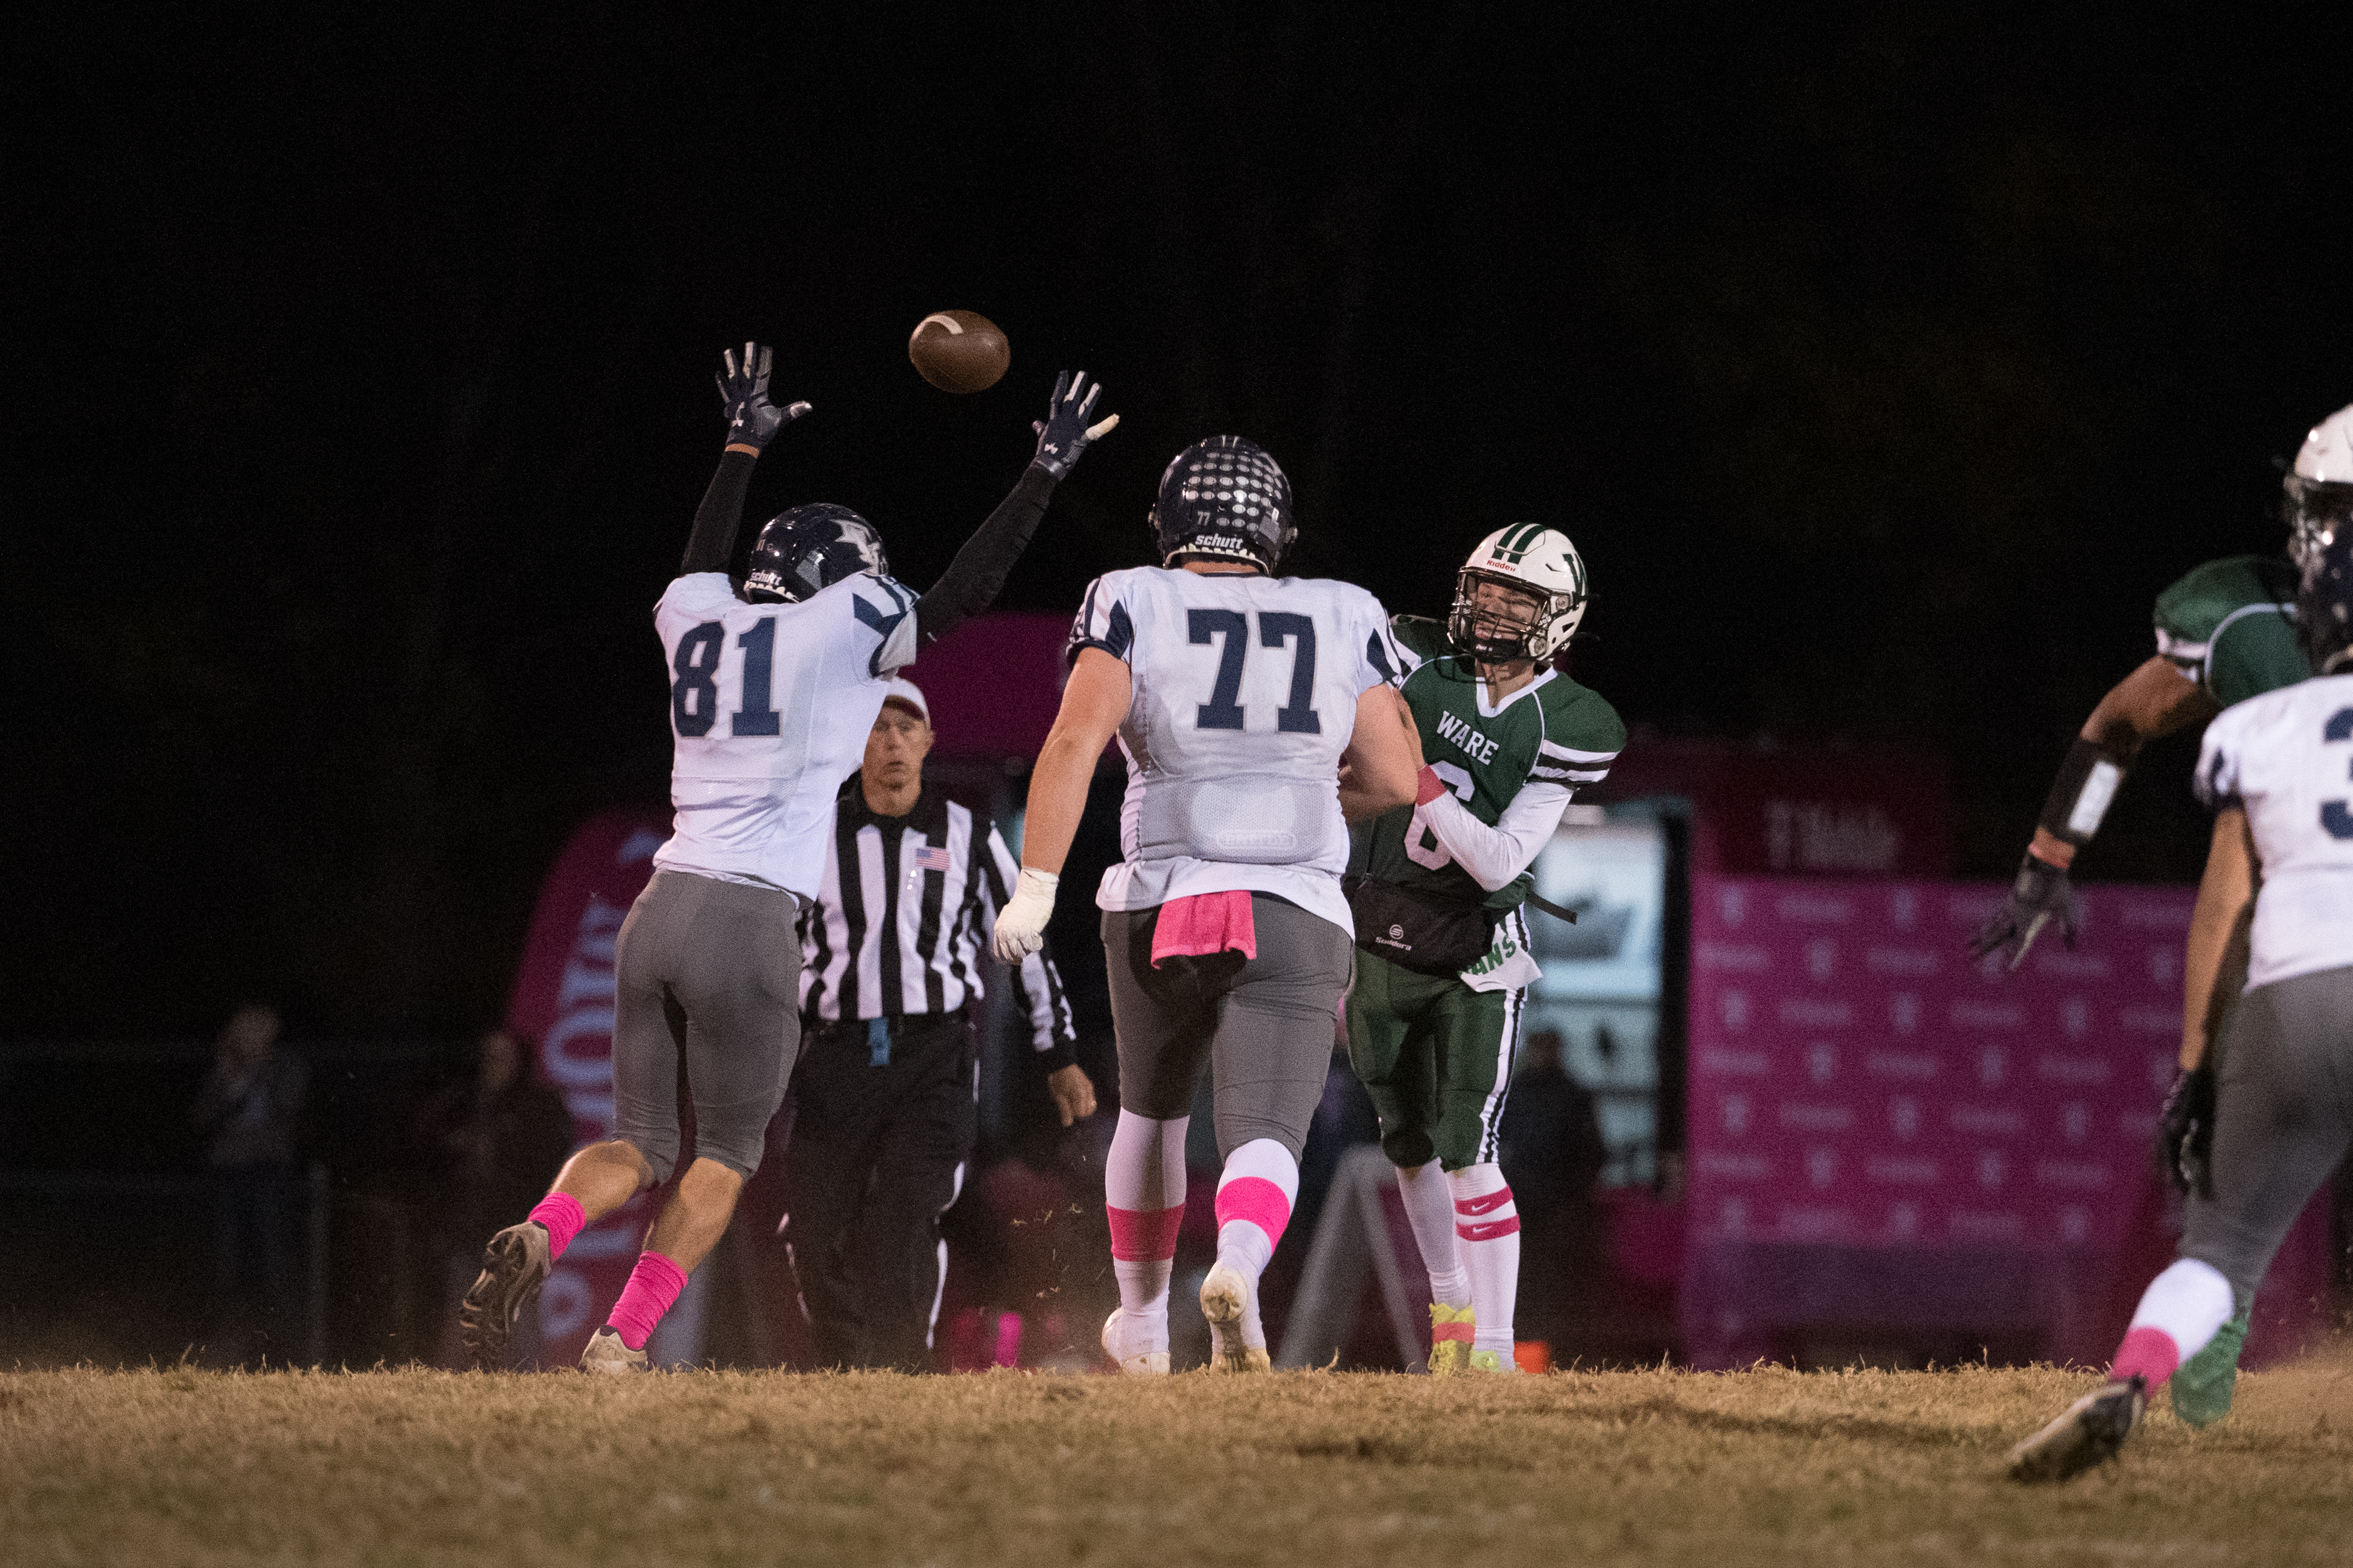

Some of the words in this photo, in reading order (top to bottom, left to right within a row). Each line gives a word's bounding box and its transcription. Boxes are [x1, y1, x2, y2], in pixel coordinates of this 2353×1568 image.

[1195, 533, 1243, 550] schutt
[1197, 511, 1210, 526] 77
[673, 615, 783, 738] 81
[1185, 608, 1322, 734] 77
[1436, 710, 1499, 766] WARE
